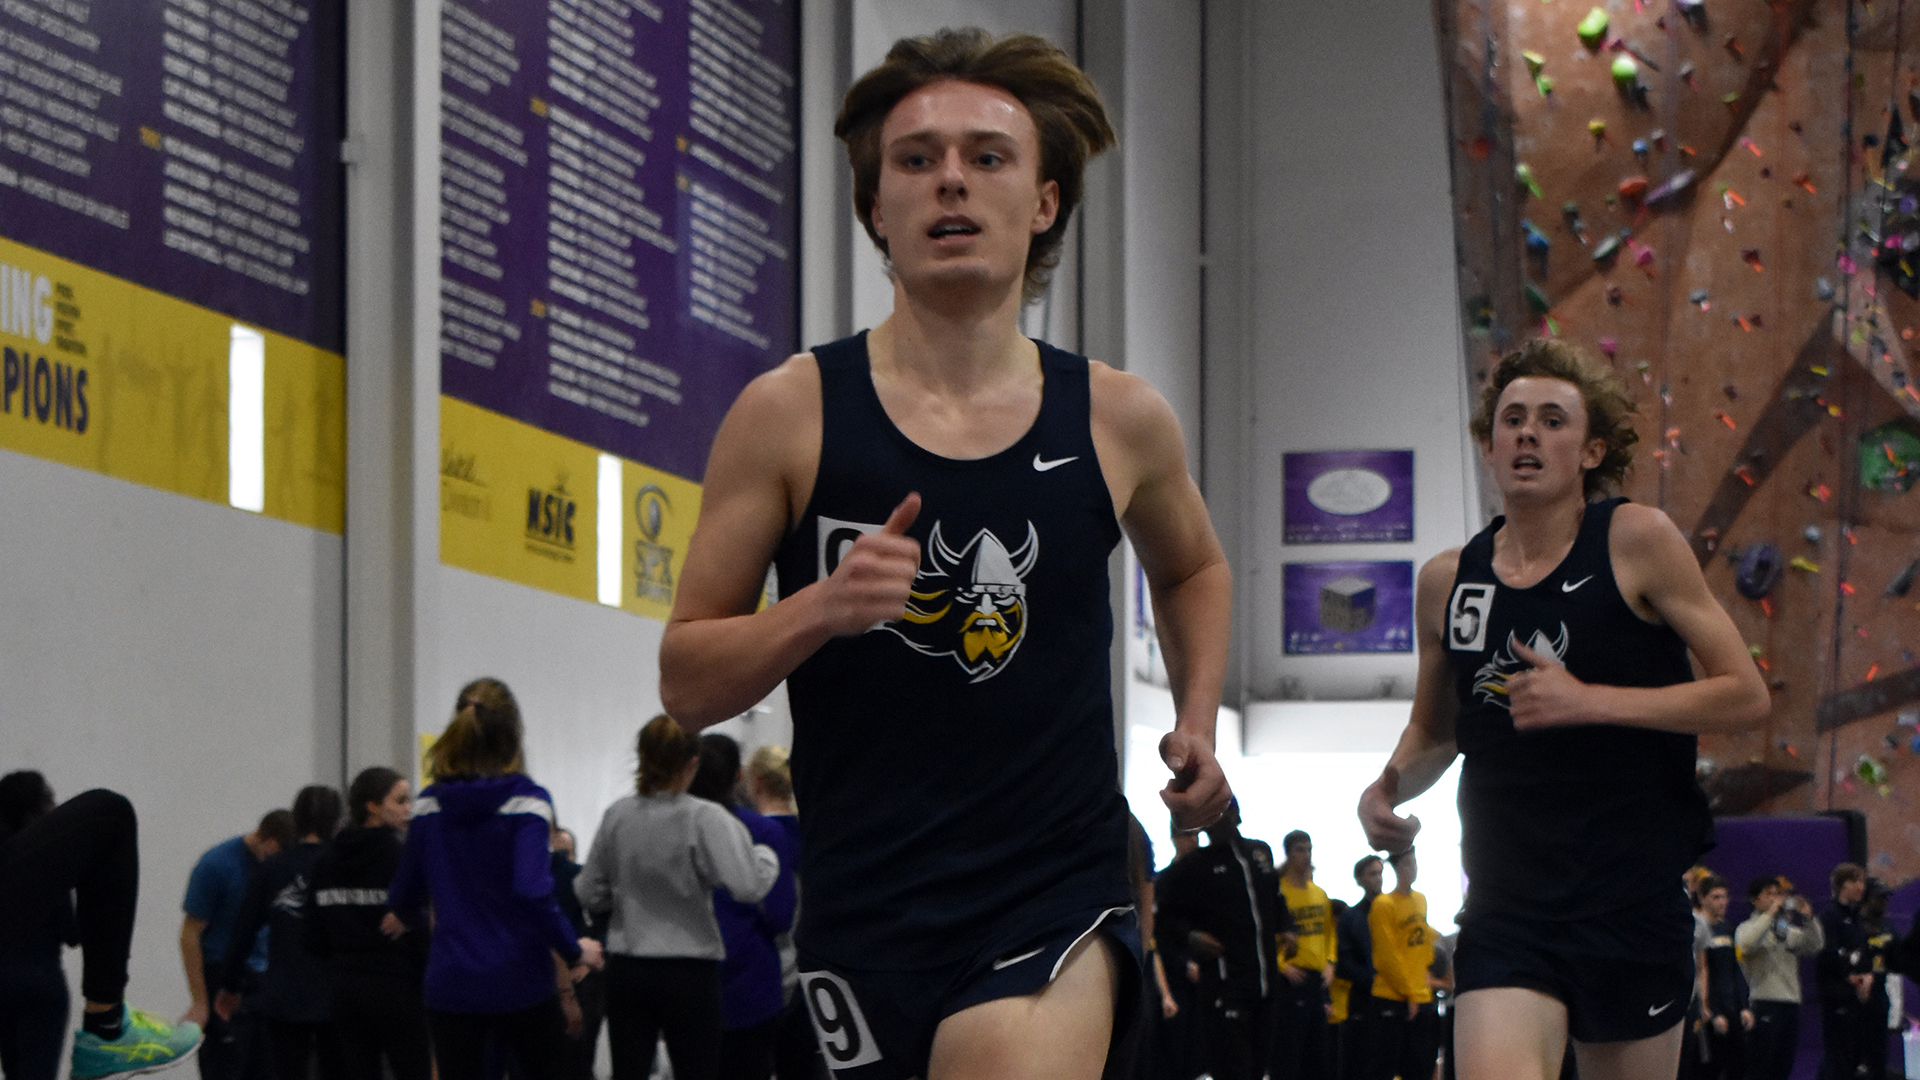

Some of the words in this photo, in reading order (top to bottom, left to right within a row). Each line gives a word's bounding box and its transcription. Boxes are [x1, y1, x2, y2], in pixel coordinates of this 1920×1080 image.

[4, 346, 88, 434] PIONS
[1453, 588, 1486, 645] 5
[808, 977, 861, 1062] 9
